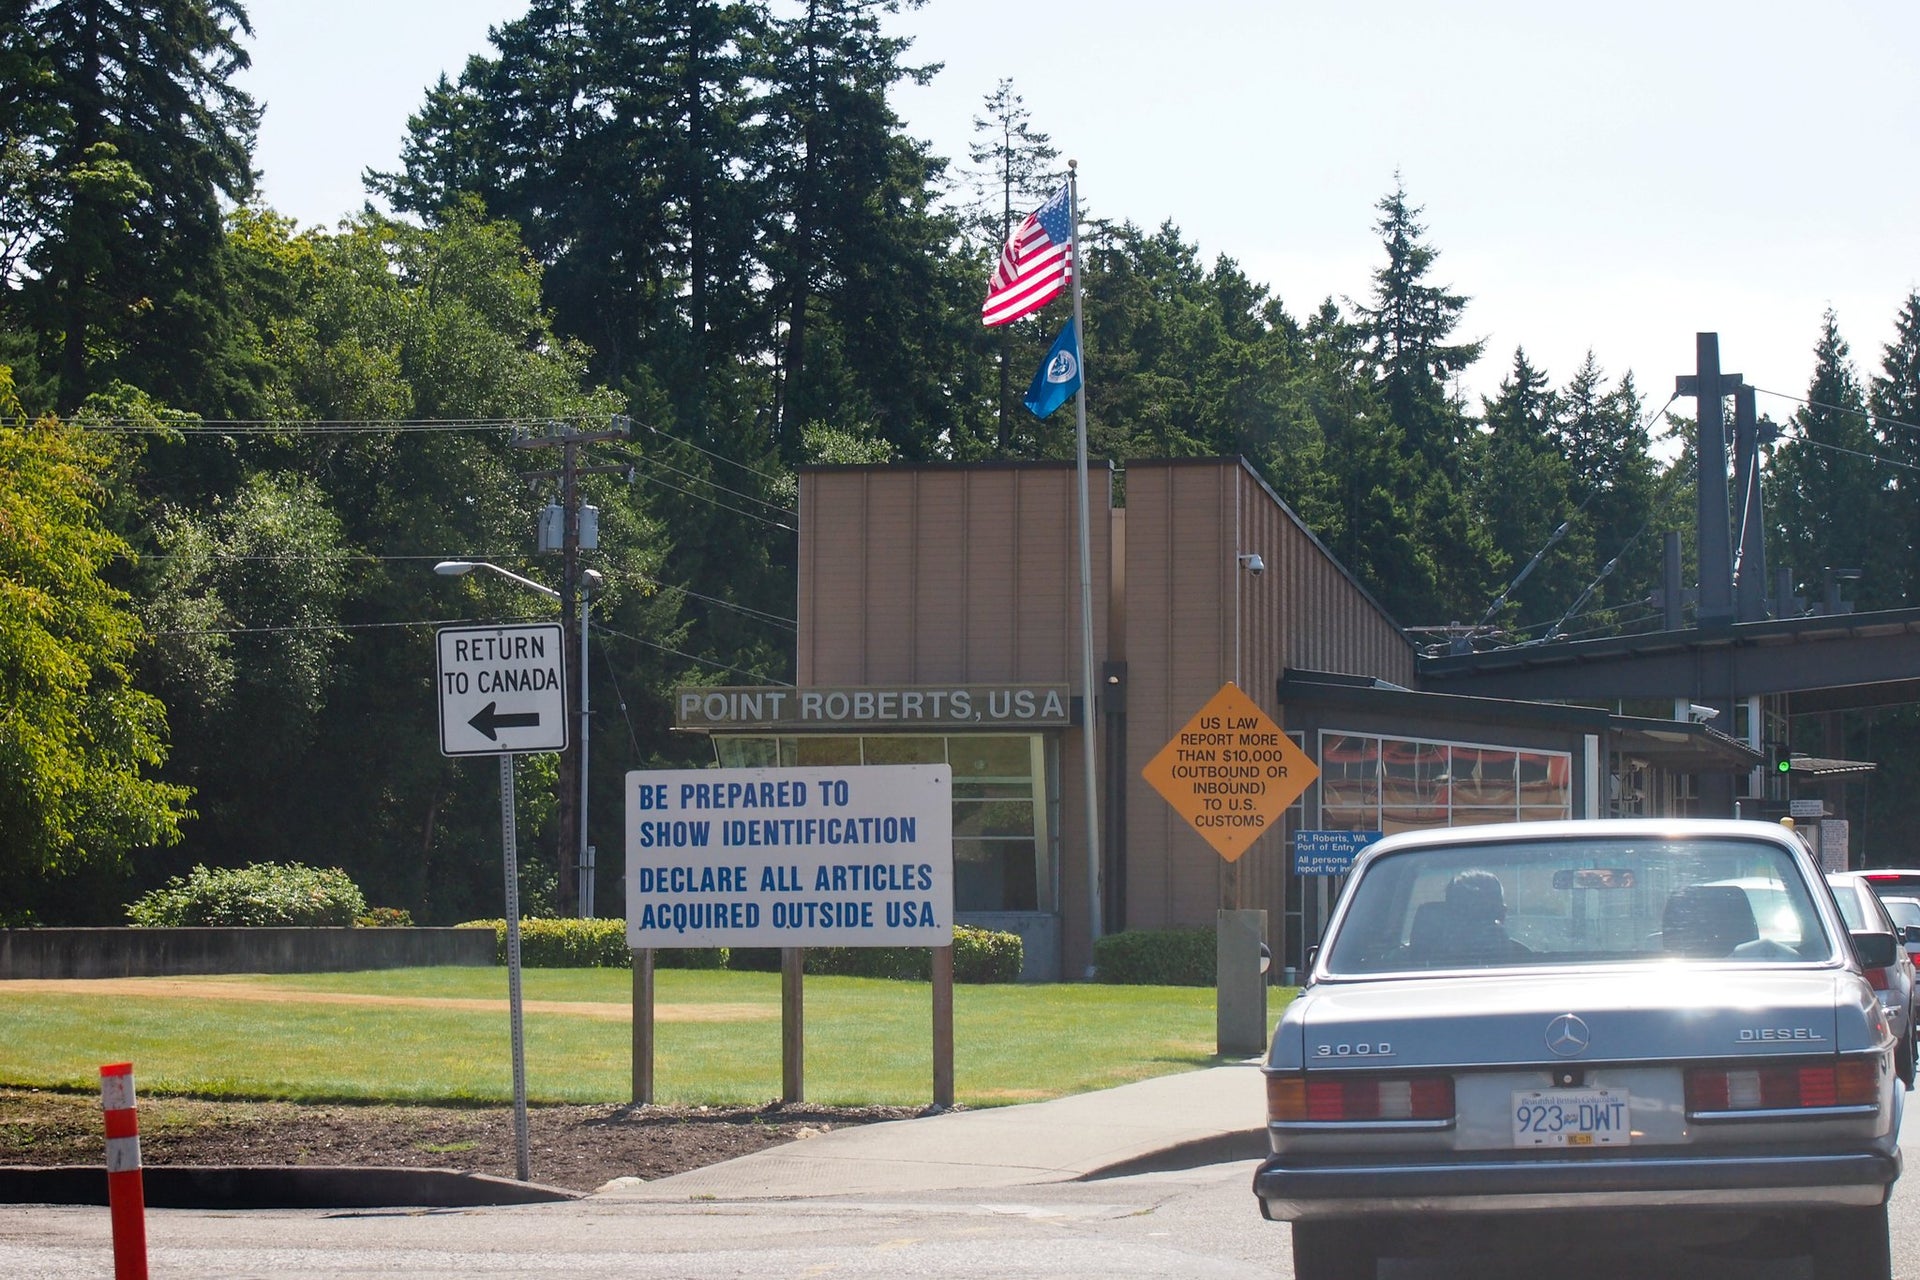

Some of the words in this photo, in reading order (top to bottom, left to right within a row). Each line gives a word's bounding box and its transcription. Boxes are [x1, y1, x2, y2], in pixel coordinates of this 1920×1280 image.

[455, 636, 545, 662] RETURN
[444, 672, 469, 695] TO
[478, 668, 559, 694] CANADA
[681, 692, 786, 721] POINT
[801, 691, 982, 722] ROBERTS,
[989, 690, 1065, 718] USA
[1200, 717, 1221, 730] US
[1227, 717, 1259, 730] LAW
[1181, 733, 1234, 746] REPORT
[1239, 733, 1279, 746] MORE
[1177, 749, 1216, 762] THAN
[1223, 749, 1283, 763] $10,000
[1172, 766, 1260, 779] (OUTBOUND
[1266, 766, 1288, 778] OR
[639, 784, 668, 810] BE
[680, 781, 807, 809] PREPARED
[818, 780, 849, 807] TO
[1193, 781, 1266, 795] INBOUND)
[1203, 798, 1222, 811] TO
[1228, 798, 1257, 811] U.S.
[1195, 814, 1265, 828] CUSTOMS
[640, 820, 710, 848] SHOW
[723, 817, 916, 846] IDENTIFICATION
[1297, 843, 1316, 851] Port
[1319, 843, 1329, 851] of
[1332, 843, 1355, 853] Entry
[1298, 856, 1309, 864] All
[1312, 857, 1348, 866] persons
[1297, 865, 1322, 874] report
[1325, 865, 1337, 873] for
[640, 866, 747, 893] DECLARE
[760, 866, 803, 892] ALL
[814, 863, 932, 891] ARTICLES
[641, 903, 759, 933] ACQUIRED
[772, 902, 873, 929] OUTSIDE
[886, 901, 935, 928] USA
[1740, 1028, 1822, 1040] DIESEL
[1517, 1105, 1564, 1132] 923
[1579, 1103, 1625, 1131] DWT
